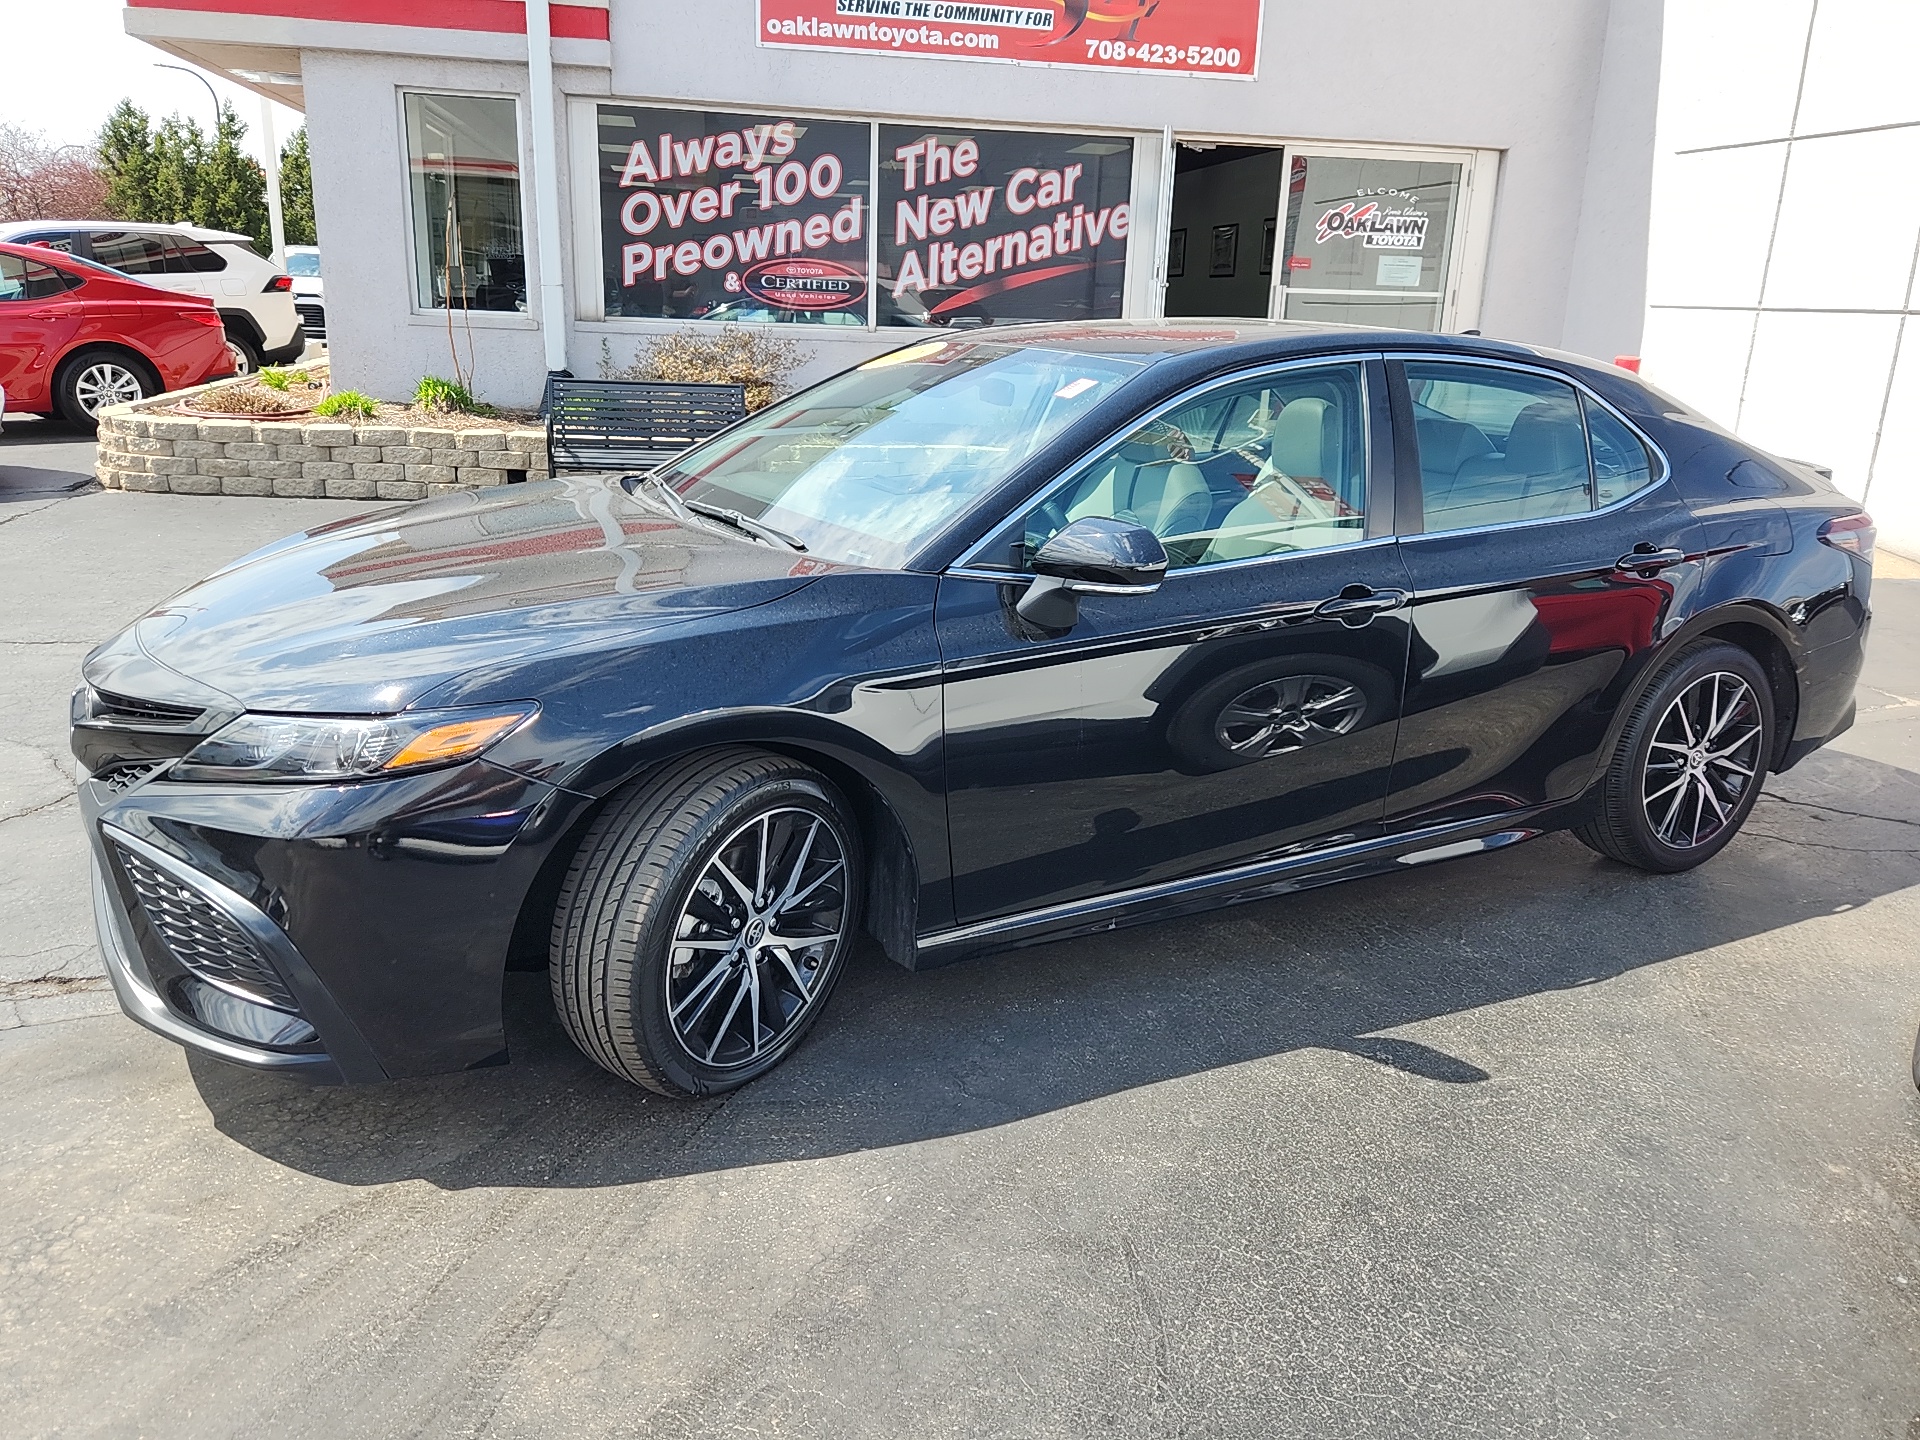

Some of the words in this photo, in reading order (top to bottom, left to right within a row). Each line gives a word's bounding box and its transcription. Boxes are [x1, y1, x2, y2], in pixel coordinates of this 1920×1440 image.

[766, 16, 999, 49] oaklawntoyota.com
[837, 0, 901, 16] SERVING
[904, 1, 930, 18] THE
[933, 4, 1024, 25] COMMUNITY
[1025, 11, 1053, 27] FOR
[619, 121, 797, 187] Always
[896, 137, 979, 191] The
[621, 181, 741, 236] Over
[754, 154, 843, 210] 100
[896, 186, 995, 245] New
[1005, 162, 1083, 215] Car
[622, 195, 863, 287] Preowned
[892, 203, 1131, 298] Alternative
[1371, 235, 1418, 246] TOYOTA
[723, 271, 742, 292] &
[796, 266, 824, 275] TOYOTA
